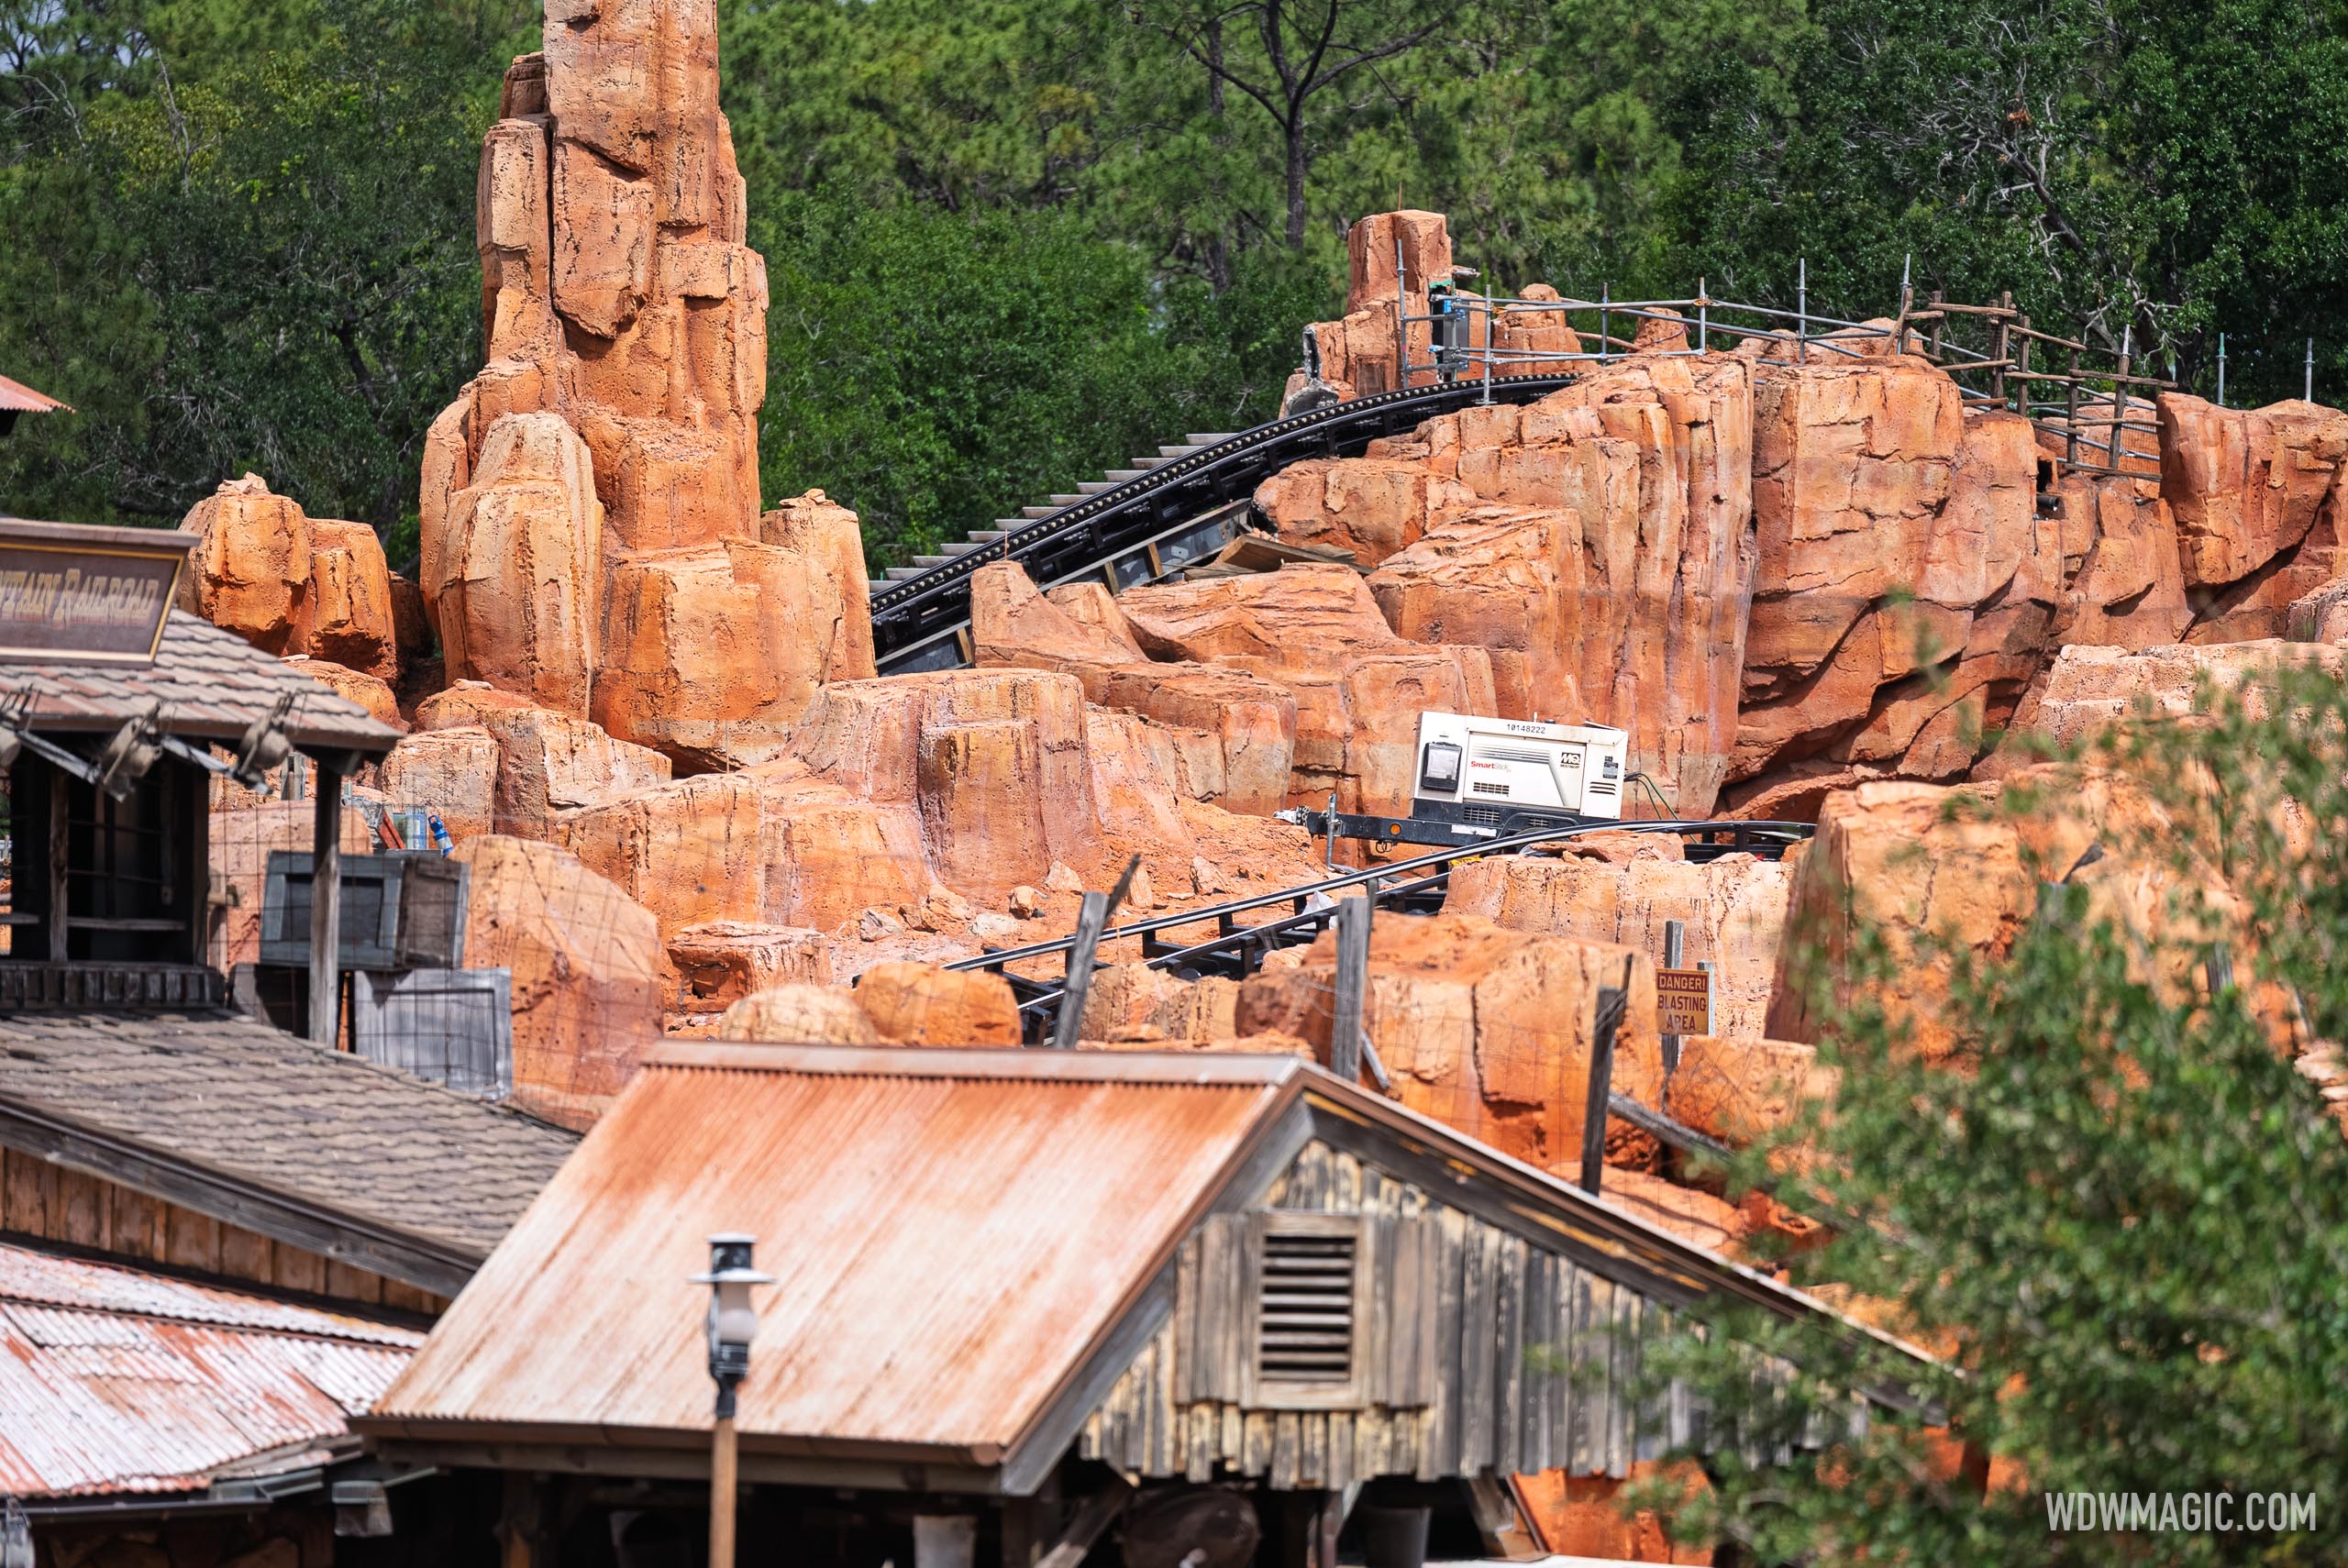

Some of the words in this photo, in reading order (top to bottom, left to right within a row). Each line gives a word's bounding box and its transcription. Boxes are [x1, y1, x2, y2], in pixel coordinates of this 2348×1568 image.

[1507, 723, 1546, 734] 10148222
[1659, 976, 1706, 990] DANGER!
[1657, 994, 1707, 1011] BLASTING
[1667, 1014, 1696, 1030] AREA
